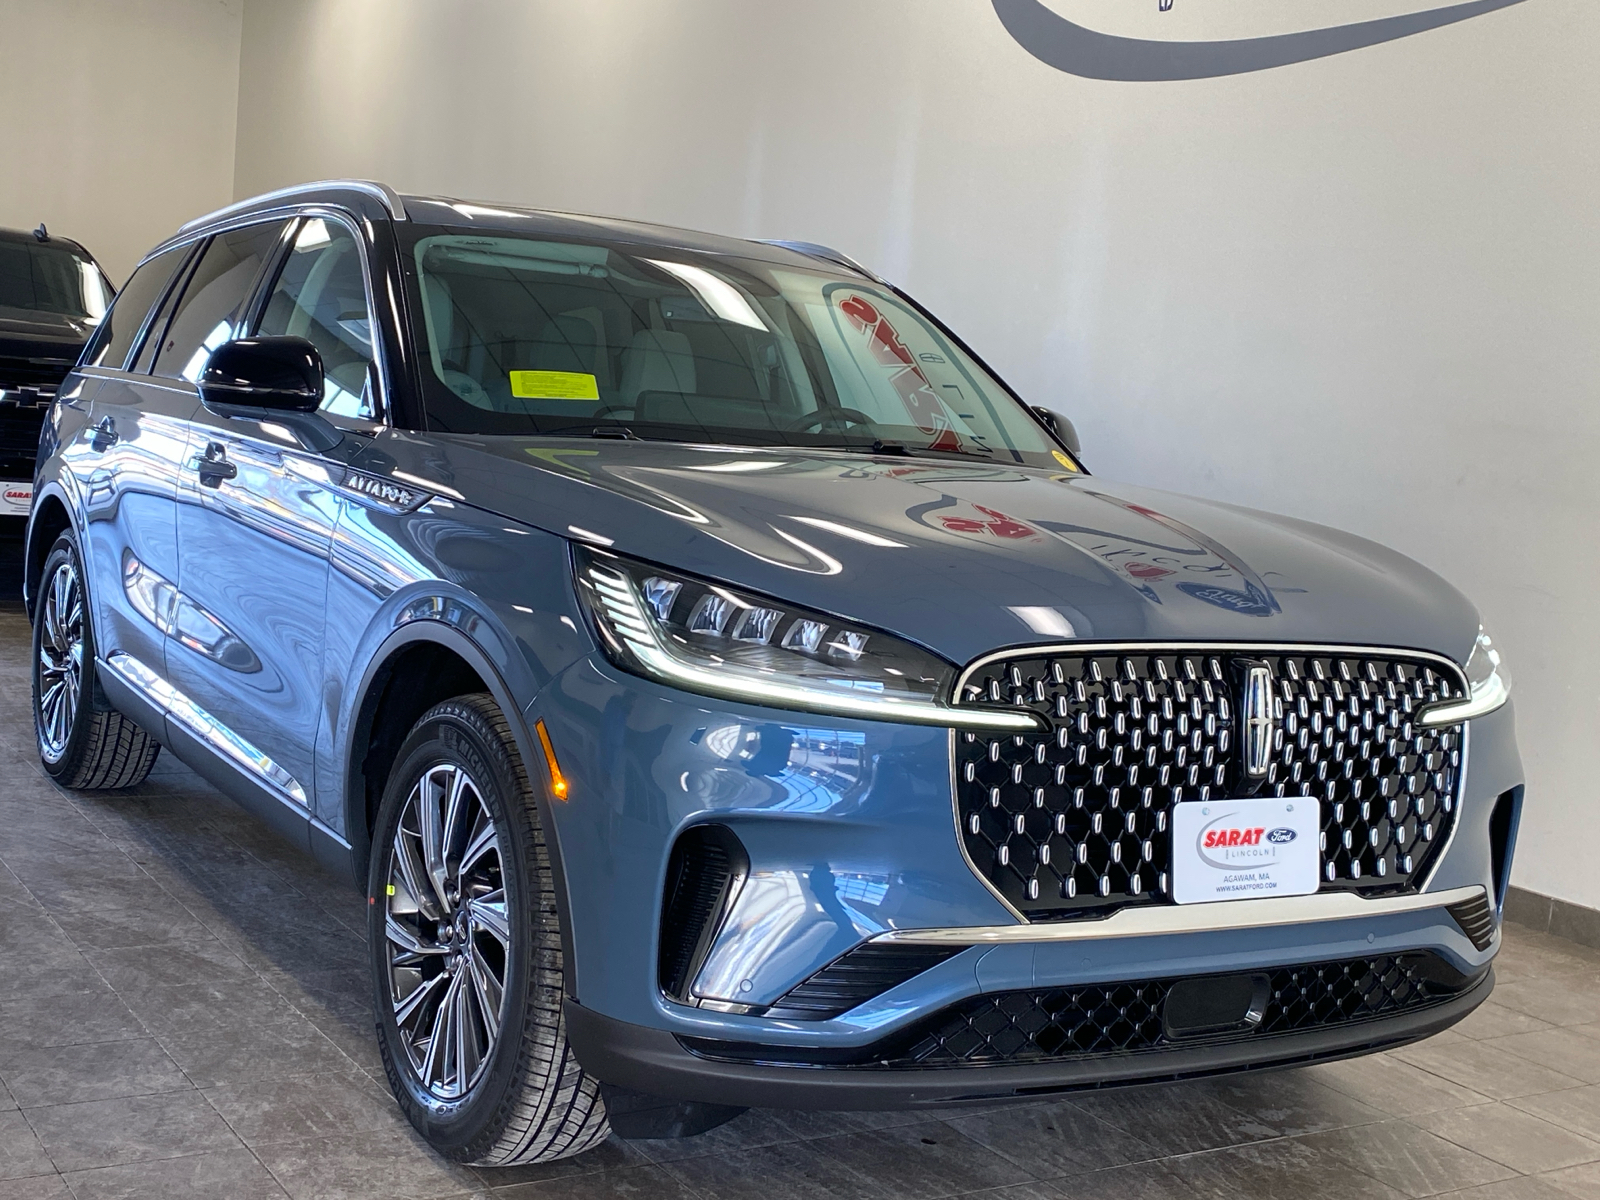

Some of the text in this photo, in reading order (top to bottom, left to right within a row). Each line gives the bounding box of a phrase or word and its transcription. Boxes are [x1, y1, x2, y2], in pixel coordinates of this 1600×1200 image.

[348, 475, 412, 506] AVIATOR
[457, 740, 501, 821] MICHELIN
[1203, 827, 1266, 848] SARAT
[1231, 849, 1270, 858] LINCOLN
[1223, 874, 1257, 883] AGAWAM,
[1215, 882, 1278, 893] WWW.SARATFORD.COM
